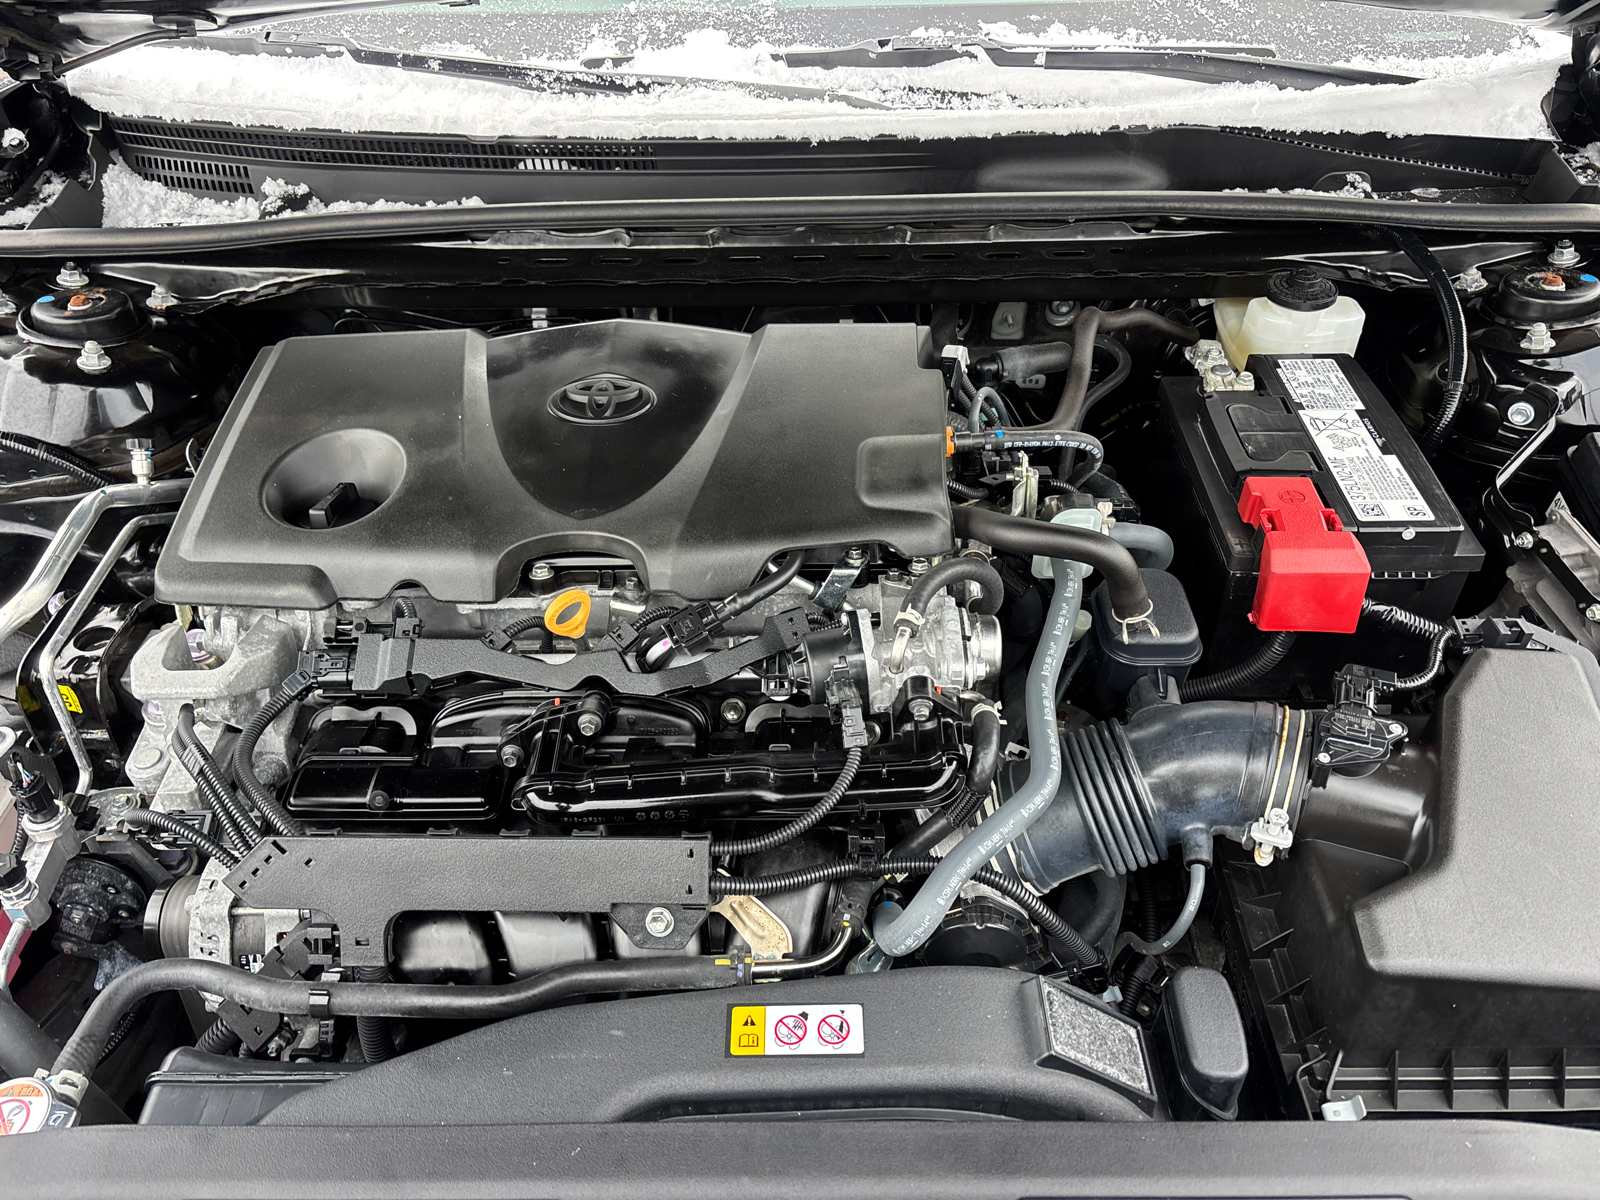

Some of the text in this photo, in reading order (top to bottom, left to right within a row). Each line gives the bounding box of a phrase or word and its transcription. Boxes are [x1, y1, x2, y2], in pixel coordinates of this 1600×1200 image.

[1351, 419, 1362, 427] Pb
[1362, 417, 1379, 438] CLARIOS
[1328, 457, 1366, 500] 375LN2-MF
[1407, 506, 1426, 516] SP
